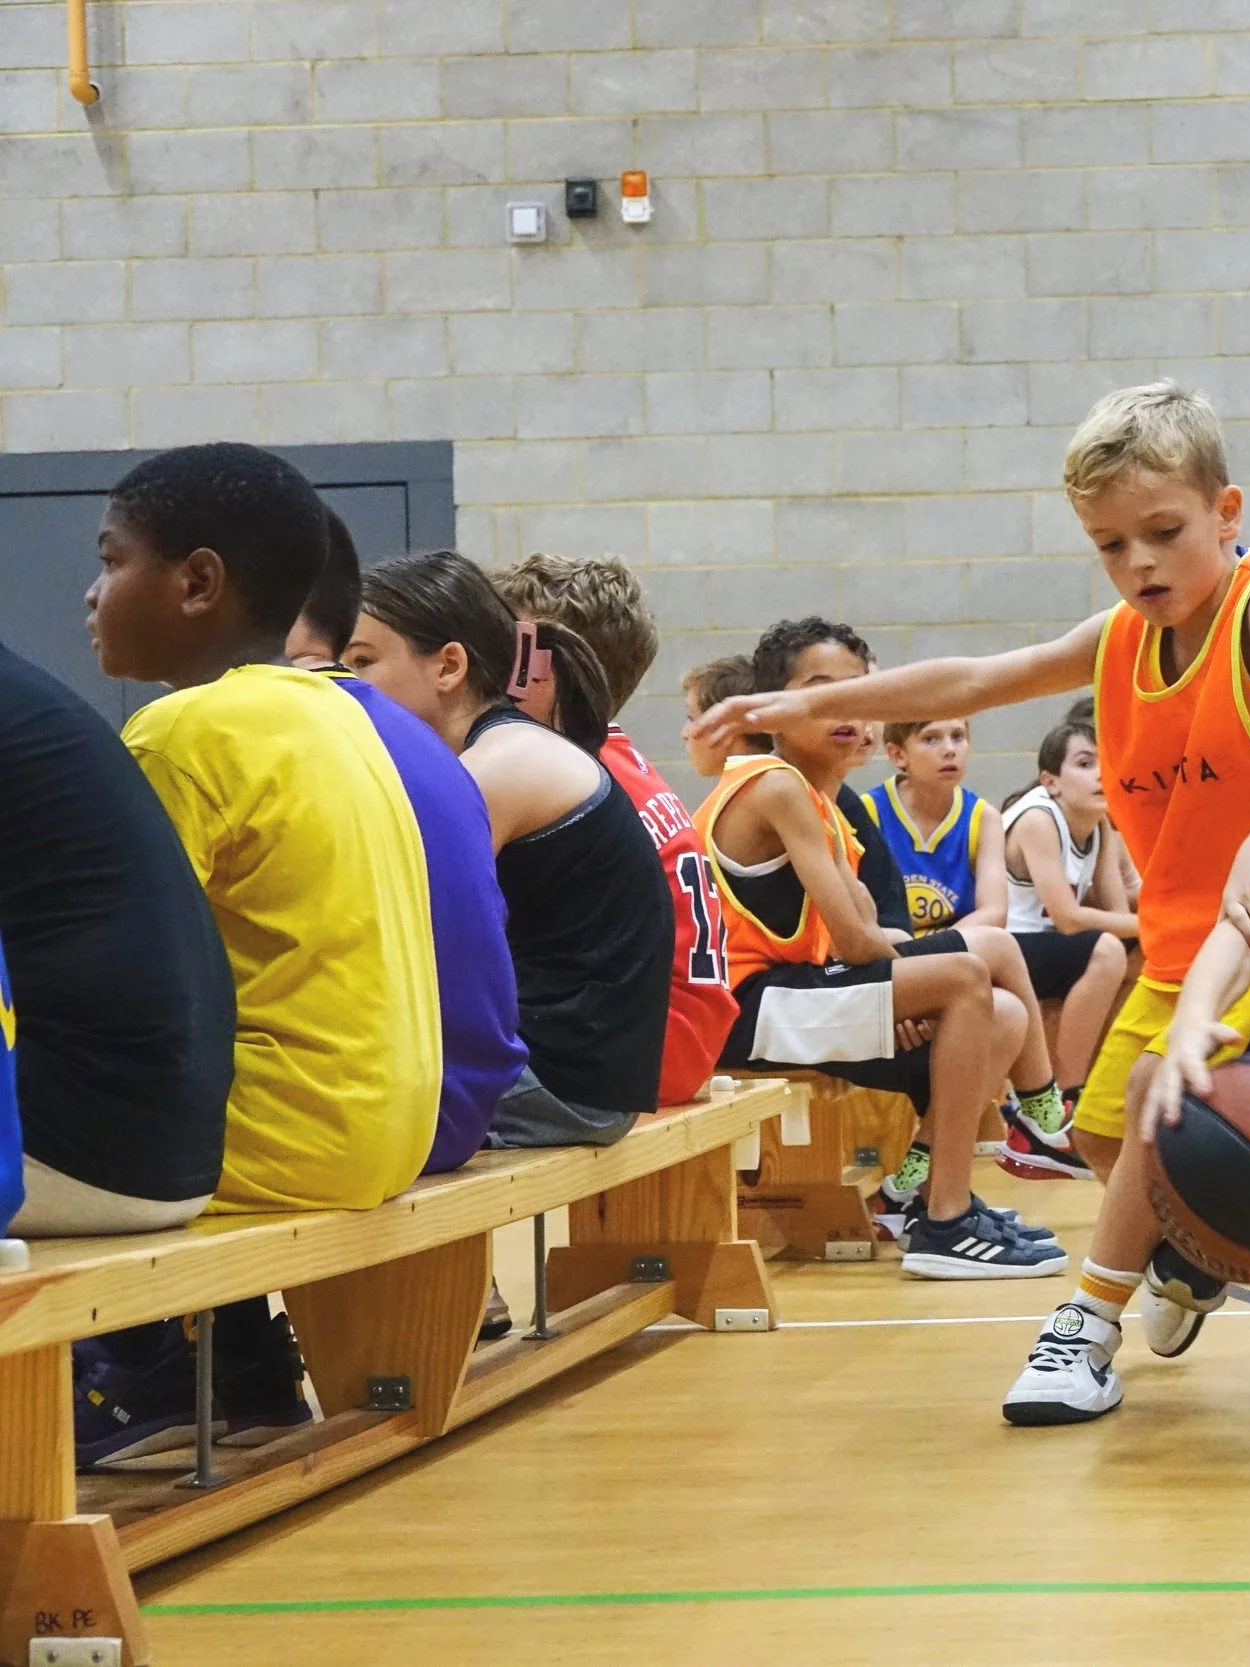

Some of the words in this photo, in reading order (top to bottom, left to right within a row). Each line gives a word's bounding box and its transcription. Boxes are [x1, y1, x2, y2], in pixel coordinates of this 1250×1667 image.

[902, 874, 928, 886] DEN
[913, 896, 943, 920] 30
[35, 1611, 64, 1635] BK
[73, 1608, 96, 1629] PE
